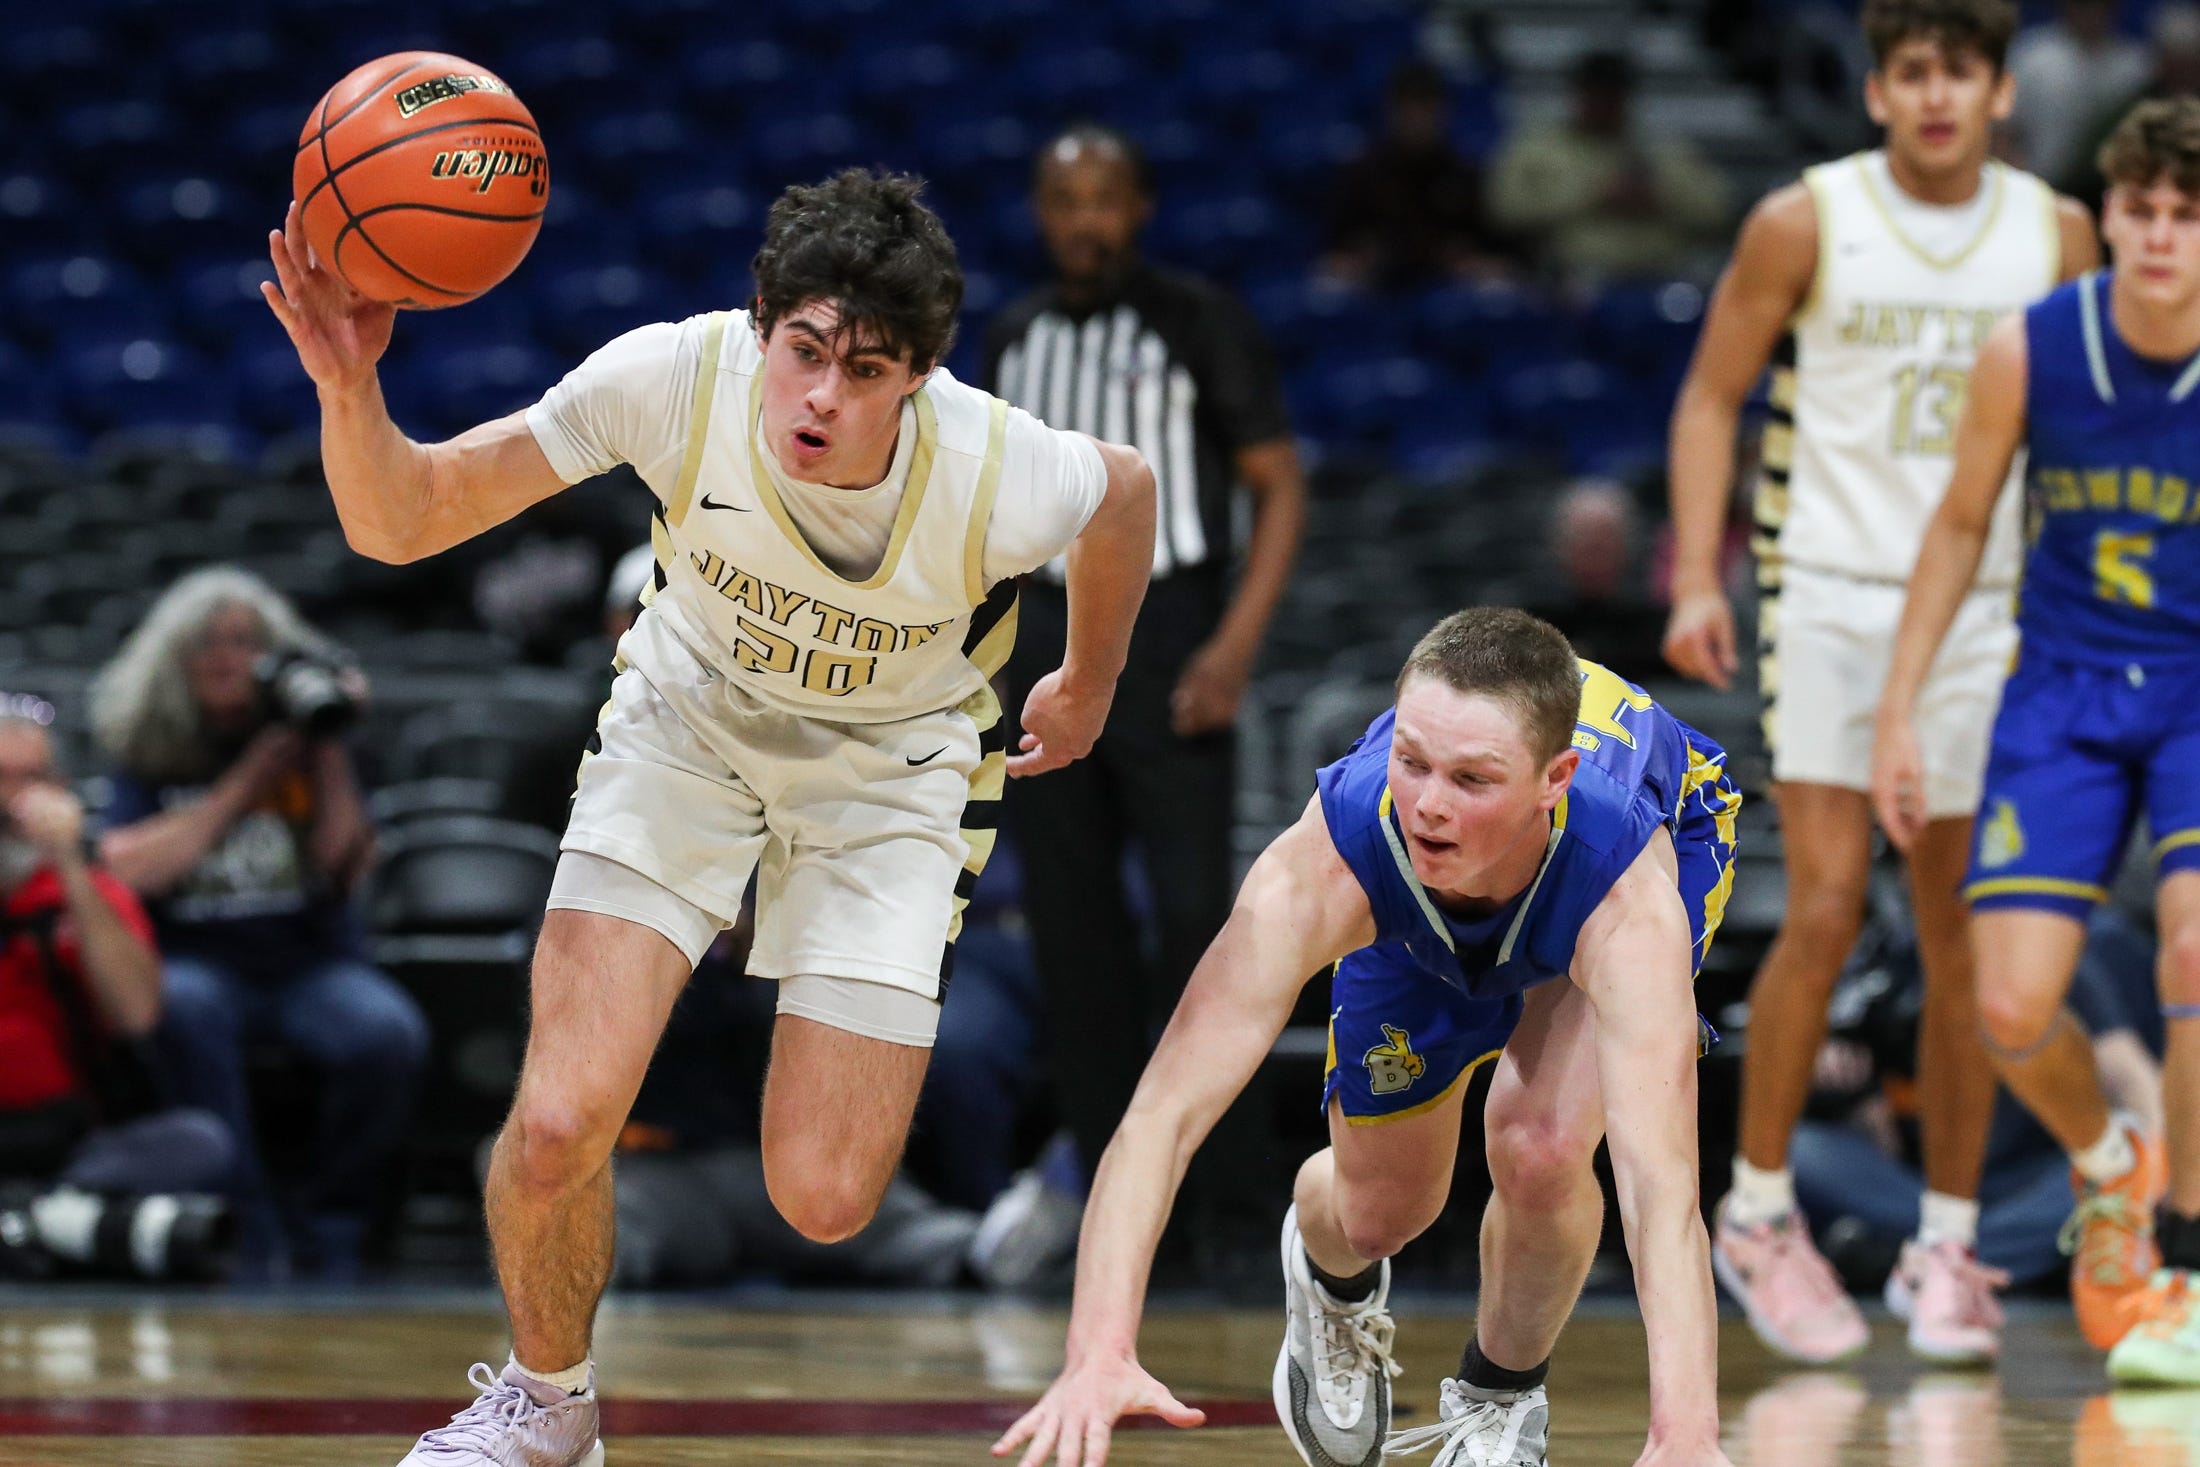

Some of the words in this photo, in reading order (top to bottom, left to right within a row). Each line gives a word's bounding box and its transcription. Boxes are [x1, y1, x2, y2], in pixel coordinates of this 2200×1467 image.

[431, 149, 548, 197] Baden
[1838, 303, 2004, 348] JAYTO
[1889, 364, 1967, 453] 13
[690, 549, 954, 651] JAYTON
[2096, 530, 2155, 608] 5
[733, 615, 877, 696] 20
